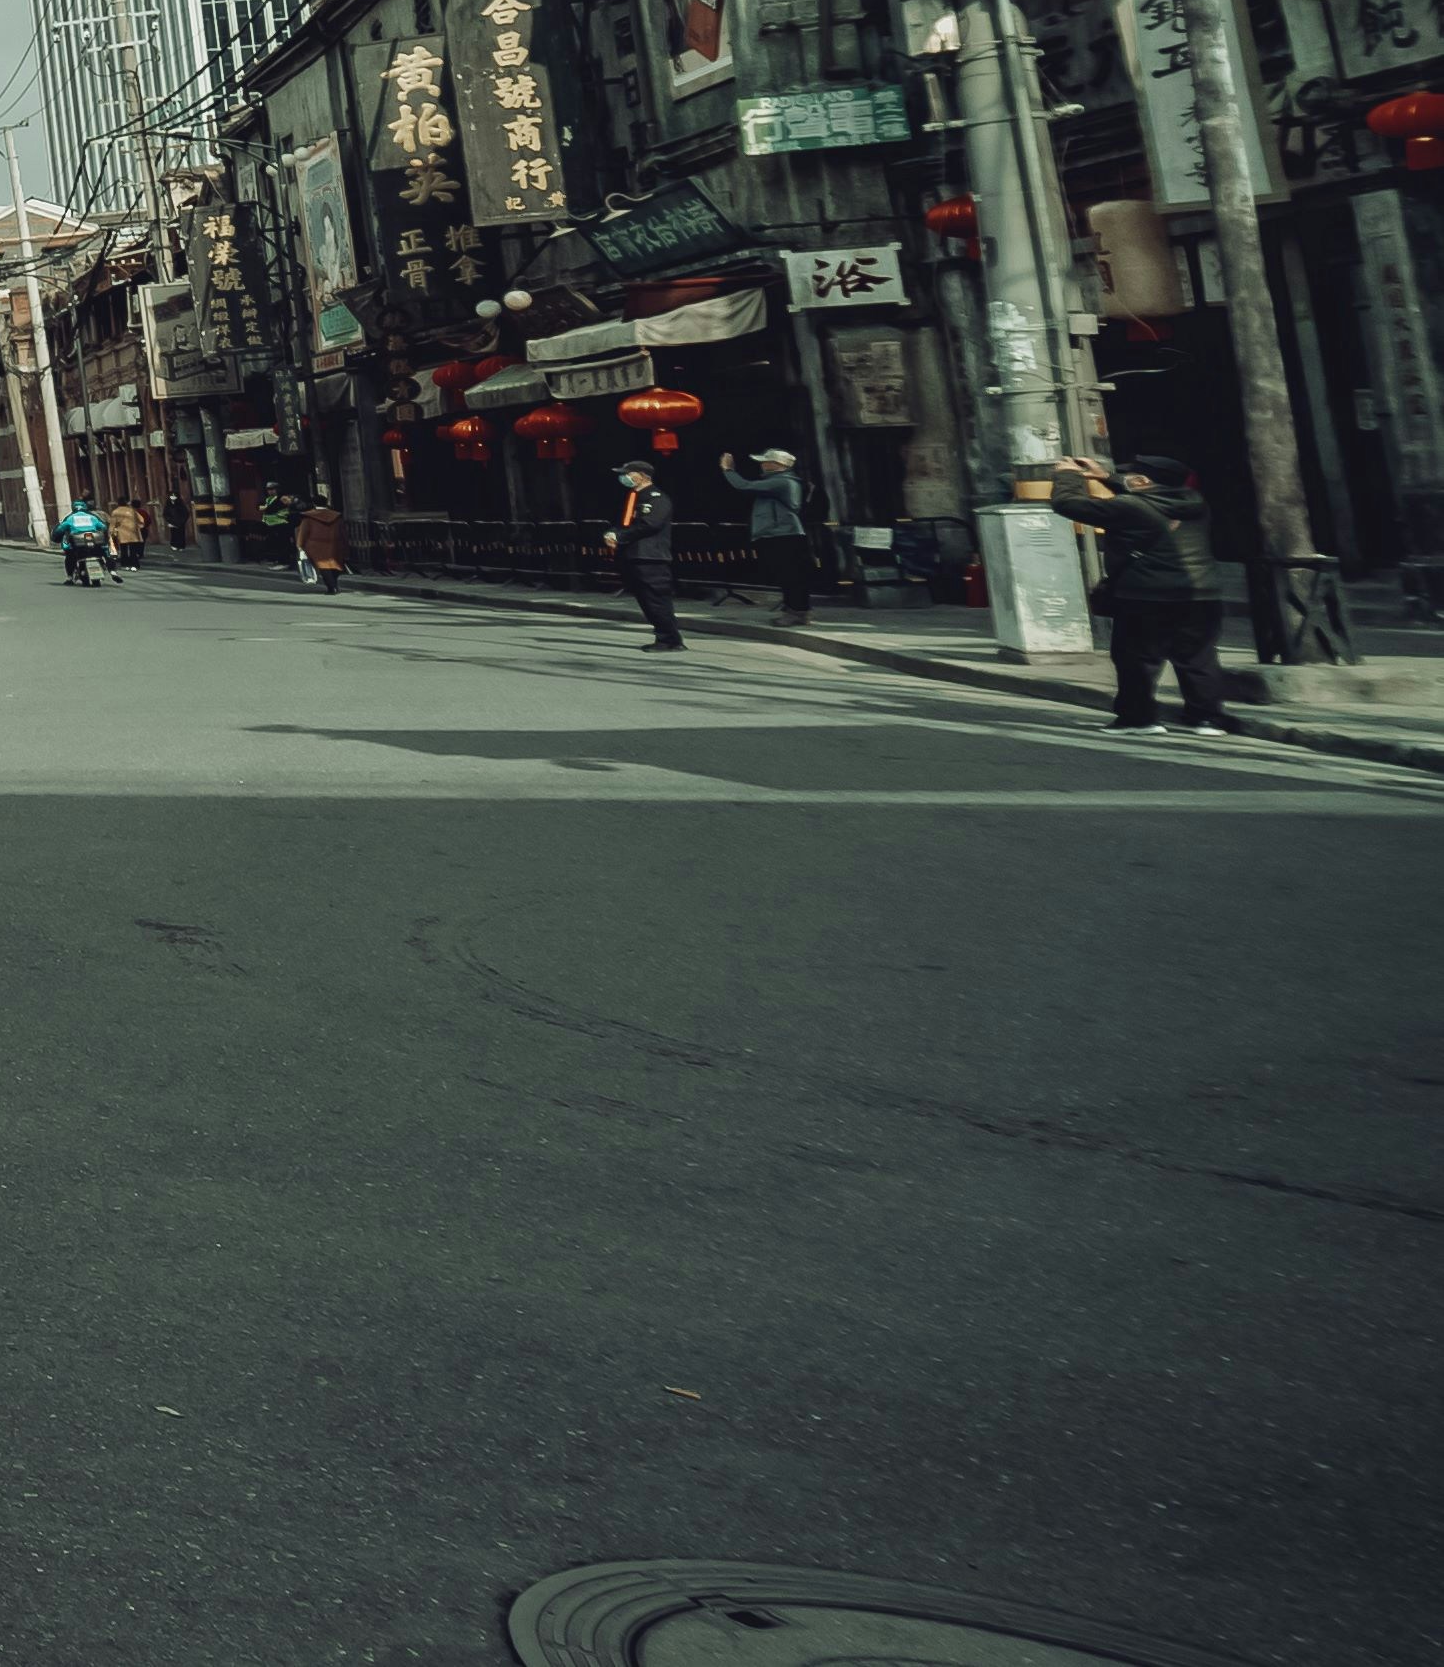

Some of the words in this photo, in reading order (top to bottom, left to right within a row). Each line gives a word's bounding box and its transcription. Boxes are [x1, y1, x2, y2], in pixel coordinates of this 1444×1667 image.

[380, 45, 461, 205] 黃柏英
[396, 229, 435, 297] 正骨
[444, 224, 486, 285] 推拿
